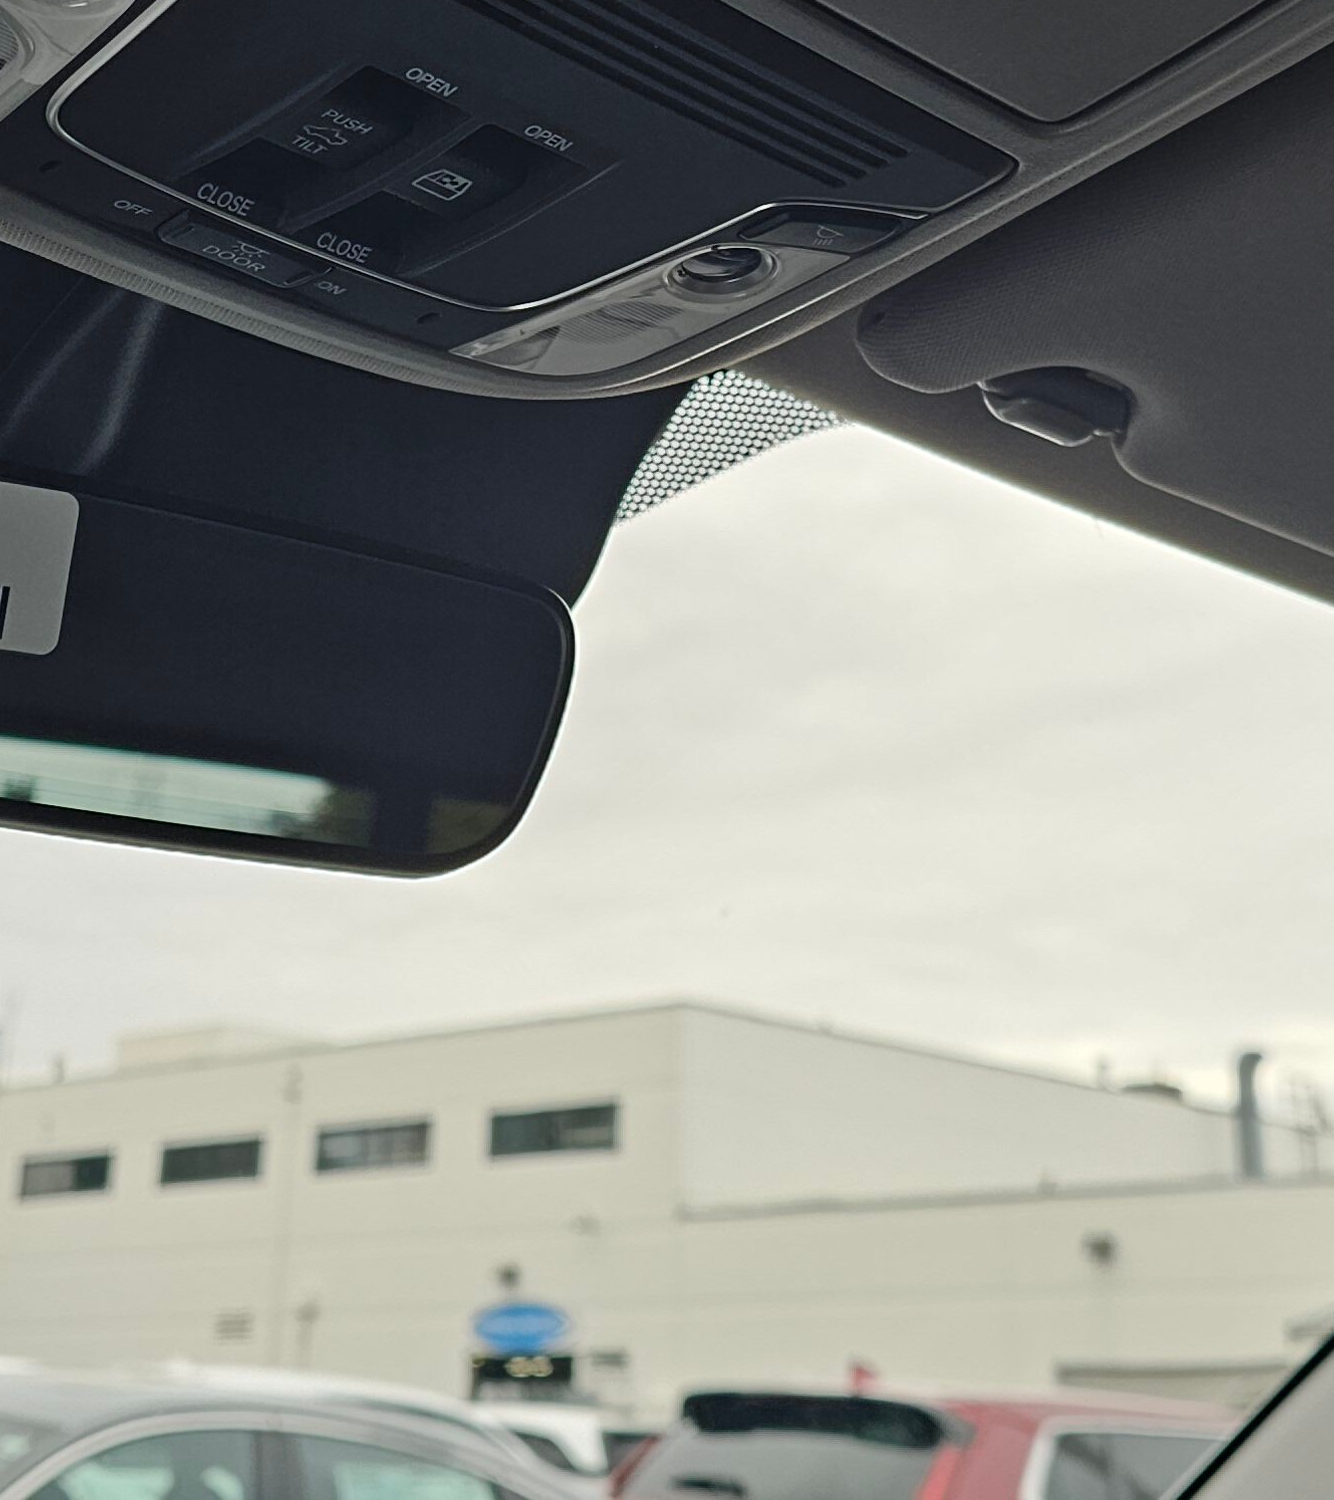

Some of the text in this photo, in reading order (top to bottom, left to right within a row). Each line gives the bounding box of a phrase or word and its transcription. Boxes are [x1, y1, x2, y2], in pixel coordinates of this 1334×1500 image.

[405, 66, 459, 98] OPEN
[320, 108, 374, 136] PUSH
[291, 135, 329, 155] TILT
[523, 124, 574, 152] OPEN
[113, 199, 154, 218] OFF
[197, 182, 255, 218] CLOSE
[202, 244, 267, 273] DOOR
[316, 231, 373, 265] CLOSE
[318, 280, 347, 296] ON
